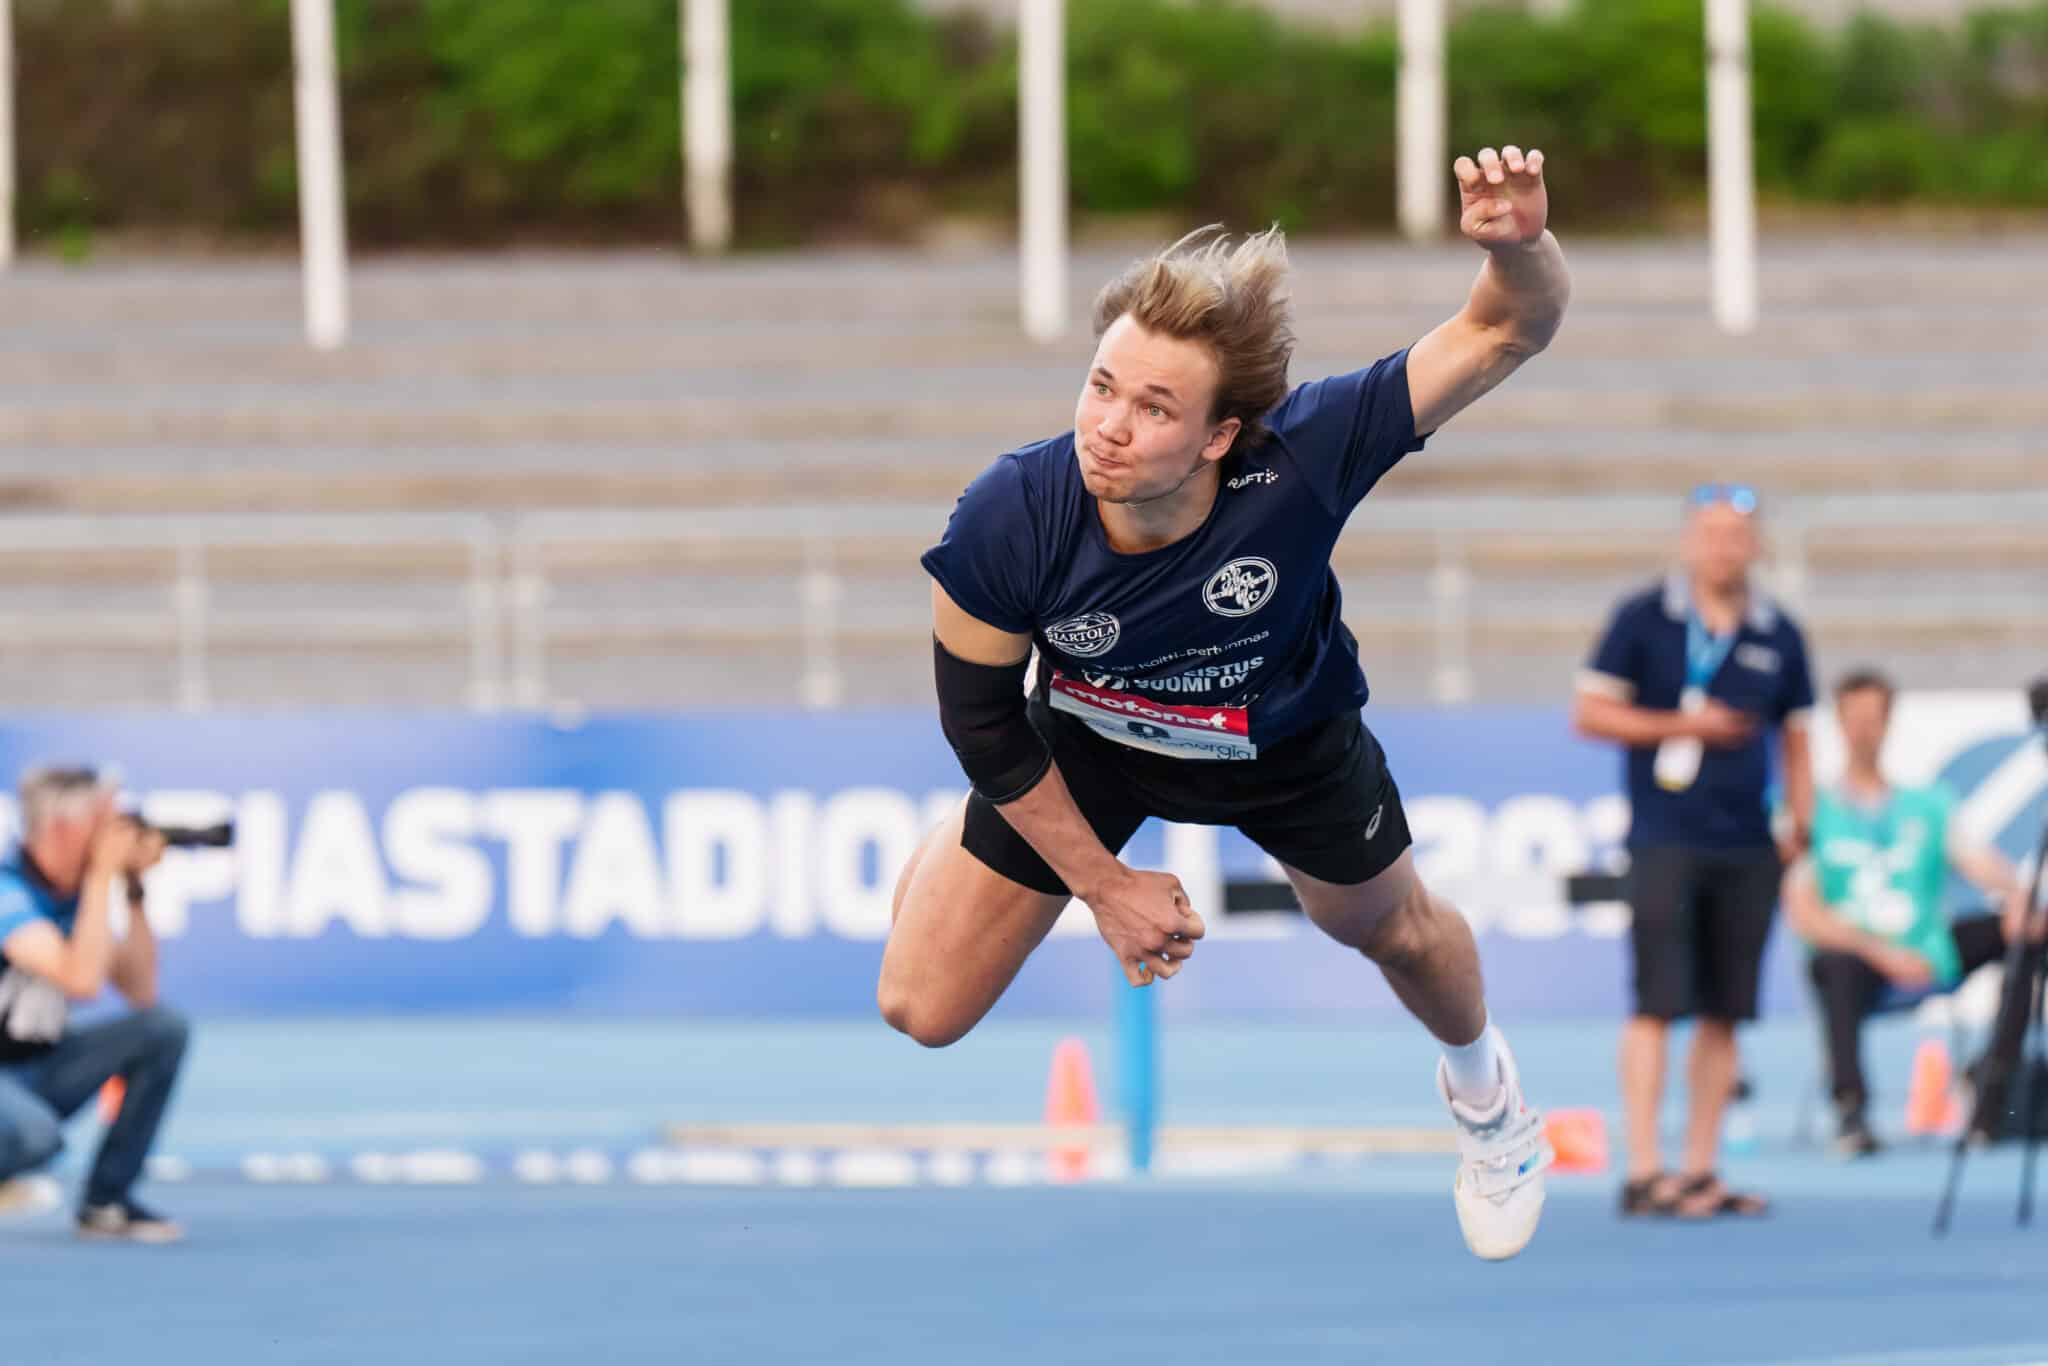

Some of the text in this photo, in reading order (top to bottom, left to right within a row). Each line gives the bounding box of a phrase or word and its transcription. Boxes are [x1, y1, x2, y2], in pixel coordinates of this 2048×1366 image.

[1227, 472, 1264, 489] RAFT
[1219, 672, 1248, 689] OY
[1065, 685, 1228, 730] motonet
